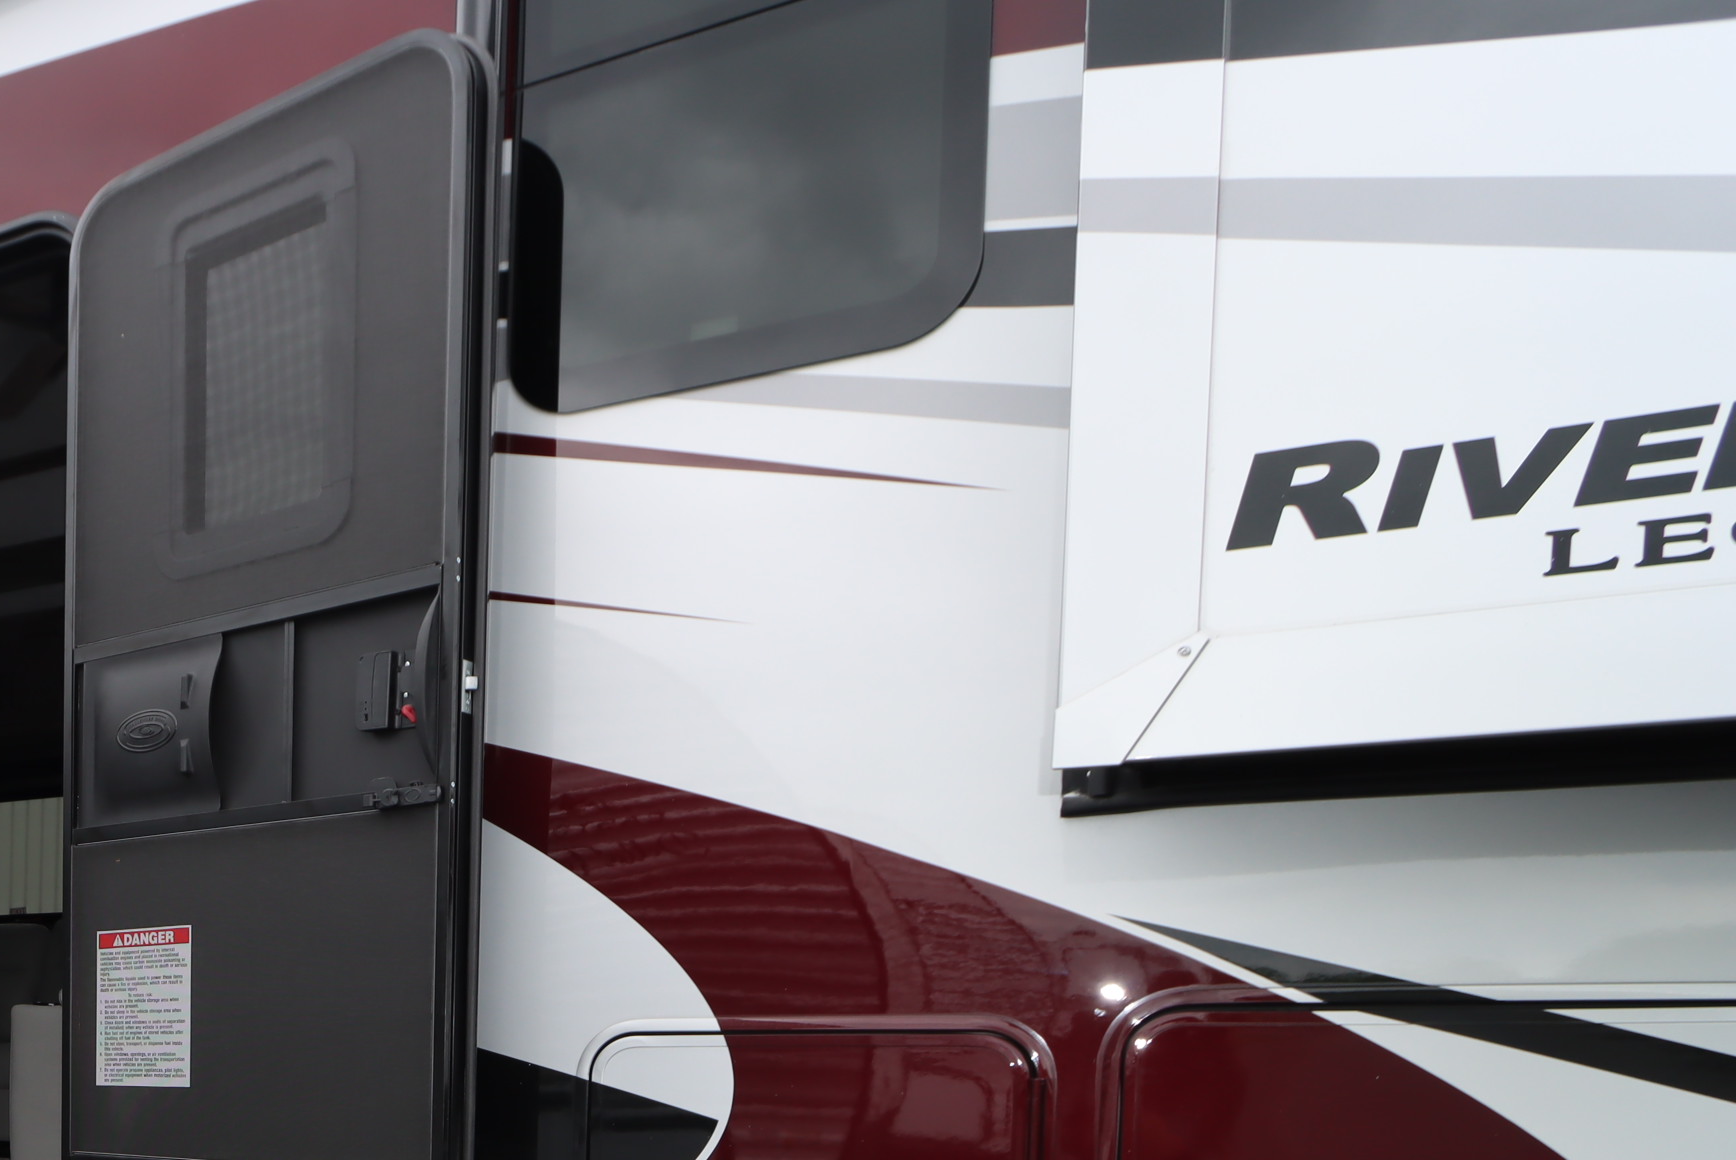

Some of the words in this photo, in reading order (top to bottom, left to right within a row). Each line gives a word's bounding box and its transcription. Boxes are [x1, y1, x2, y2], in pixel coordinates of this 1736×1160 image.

[1225, 401, 1736, 551] RIVE
[1543, 512, 1736, 577] LE
[123, 930, 175, 946] DANGER
